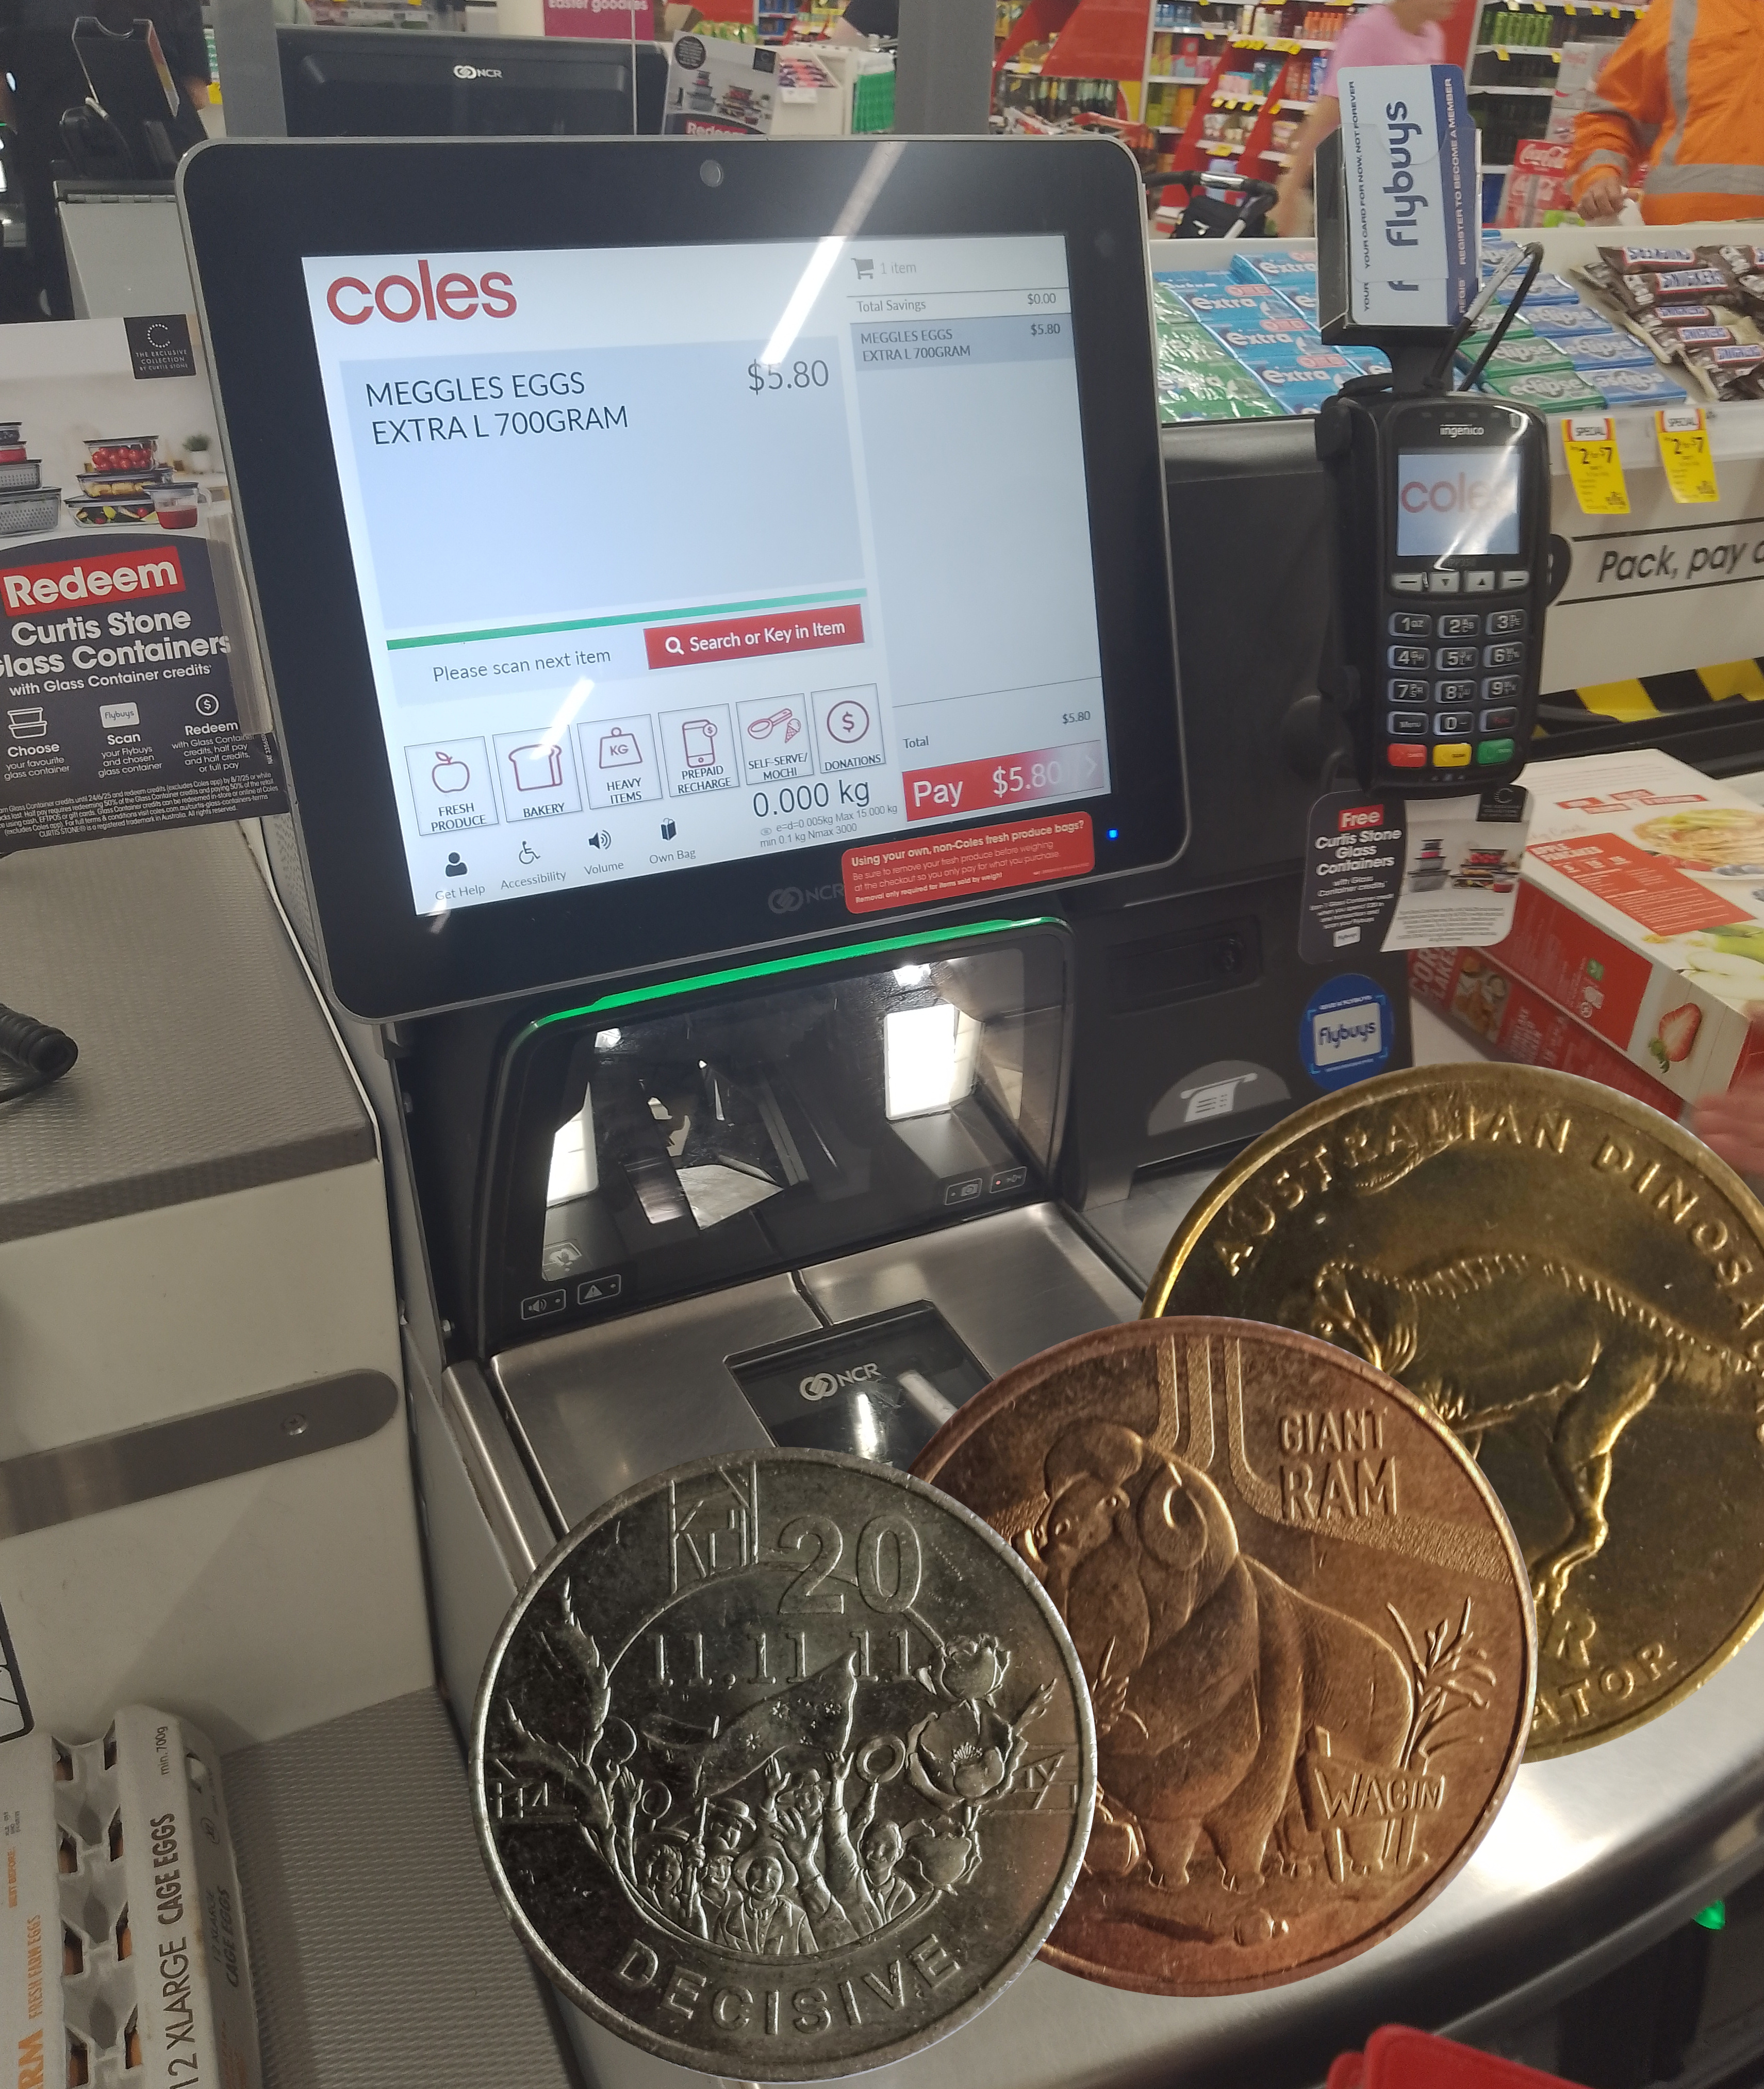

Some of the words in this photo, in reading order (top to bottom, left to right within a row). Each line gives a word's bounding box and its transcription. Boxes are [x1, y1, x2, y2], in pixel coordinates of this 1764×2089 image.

[477, 69, 502, 78] NCR
[1349, 81, 1358, 129] FOREVER
[1444, 78, 1455, 127] MEMBER
[1450, 129, 1457, 138] A
[1382, 101, 1428, 246] flybuys
[1450, 140, 1461, 189] BECOME
[1454, 191, 1462, 207] TO
[1456, 209, 1466, 265] REGISTER
[890, 261, 917, 274] item
[326, 259, 517, 325] coles
[856, 300, 883, 313] Total
[886, 299, 927, 313] Savings
[1027, 292, 1056, 305] $0.00
[1192, 295, 1257, 310] extra
[860, 331, 918, 344] MEGGLES
[921, 329, 953, 340] EGGS
[1031, 322, 1060, 336] $5.80
[1226, 331, 1294, 346] extra
[863, 349, 901, 361] EXTRA
[915, 345, 971, 359] 700GRAM
[366, 375, 503, 407] MEGGLES
[512, 371, 585, 398] EGGS
[748, 359, 829, 395] $5.80
[1263, 368, 1330, 384] extra
[1510, 379, 1582, 397] eclipse
[372, 416, 467, 446] EXTRA
[473, 414, 490, 438] L
[494, 405, 629, 437] 700GRAM
[1439, 424, 1485, 438] ingenico
[1401, 472, 1495, 513] cole
[1598, 545, 1677, 583] Pack,
[1686, 543, 1748, 579] pay
[3, 561, 178, 608] Redeem
[11, 616, 101, 646] Curtis
[108, 611, 191, 636] Stone
[689, 632, 741, 652] Search
[745, 632, 760, 645] or
[764, 626, 793, 645] Key
[795, 624, 809, 638] in
[813, 620, 845, 636] Item
[0, 654, 65, 679] lass
[72, 634, 232, 669] Containers
[433, 661, 488, 682] Please
[493, 656, 530, 675] scan
[535, 652, 571, 671] next
[575, 648, 611, 666] item
[9, 682, 41, 696] with
[44, 675, 85, 692] Glass
[88, 669, 159, 687] Container
[185, 722, 239, 736] Redeem
[903, 735, 929, 749] Total
[1062, 711, 1091, 724] $5.80
[107, 734, 141, 745] Scan
[172, 740, 189, 750] with
[191, 738, 213, 747] Glass
[215, 734, 256, 744] Container
[214, 745, 230, 753] half
[232, 744, 248, 752] pay
[8, 744, 60, 758] Choose
[102, 750, 120, 759] your
[122, 746, 153, 756] Flybuys
[123, 755, 155, 765] chosen
[609, 745, 629, 756] KG
[6, 761, 26, 771] your
[27, 756, 64, 767] favourite
[98, 769, 120, 779] glass
[122, 763, 162, 775] container
[748, 753, 807, 770] SELF-SERVE/
[825, 754, 881, 771] DONATIONS
[4, 772, 26, 781] glass
[28, 765, 70, 777] container
[682, 765, 723, 780] PREPAID
[763, 767, 797, 781] MOCHI
[607, 778, 641, 791] HEAVY
[678, 777, 732, 794] RECHARGE
[913, 780, 963, 808] Pay
[992, 761, 1061, 798] $5.80
[611, 792, 641, 804] ITEMS
[753, 782, 830, 818] 0.000
[839, 779, 870, 807] kg
[438, 802, 474, 817] FRESH
[523, 803, 565, 817] BAKERY
[835, 811, 854, 823] Max
[887, 804, 897, 814] kg
[431, 815, 487, 832] PRODUCE
[1342, 811, 1380, 828] Free
[760, 837, 776, 847] min
[795, 832, 806, 843] kg
[808, 828, 834, 840] Nmax
[836, 823, 857, 834] 3000
[851, 855, 880, 866] Using
[882, 851, 905, 863] your
[908, 847, 932, 858] own,
[933, 837, 984, 854] non-Coles
[985, 832, 1010, 845] fresh
[1011, 826, 1053, 842] produce
[1054, 819, 1084, 833] bags?
[1315, 832, 1357, 849] Curtis
[1359, 829, 1402, 843] Stone
[649, 852, 675, 864] Own
[677, 849, 696, 861] Bag
[1335, 845, 1377, 859] Glass
[584, 861, 624, 876] Volume
[893, 864, 921, 874] remove
[1316, 856, 1395, 876] Containers
[500, 871, 567, 890] Accessibility
[879, 876, 915, 887] checkout
[435, 890, 456, 900] Get
[459, 884, 486, 897] Help
[805, 883, 844, 903] NCR
[855, 893, 884, 903] Removal
[1318, 1022, 1375, 1049] flybuys
[1214, 1096, 1572, 1276] AUSTRALIAN
[836, 1362, 881, 1387] NCR
[1279, 1407, 1388, 1455] GIANT
[1279, 1455, 1397, 1520] RAM
[778, 1515, 922, 1614] 20
[1315, 1768, 1445, 1820] WAGIN
[150, 1813, 179, 1868] EGGS
[155, 1869, 184, 1924] CAGE
[158, 1936, 195, 2050] XLARGE
[621, 1935, 962, 2035] DECISIVE
[18, 2029, 43, 2089] RM
